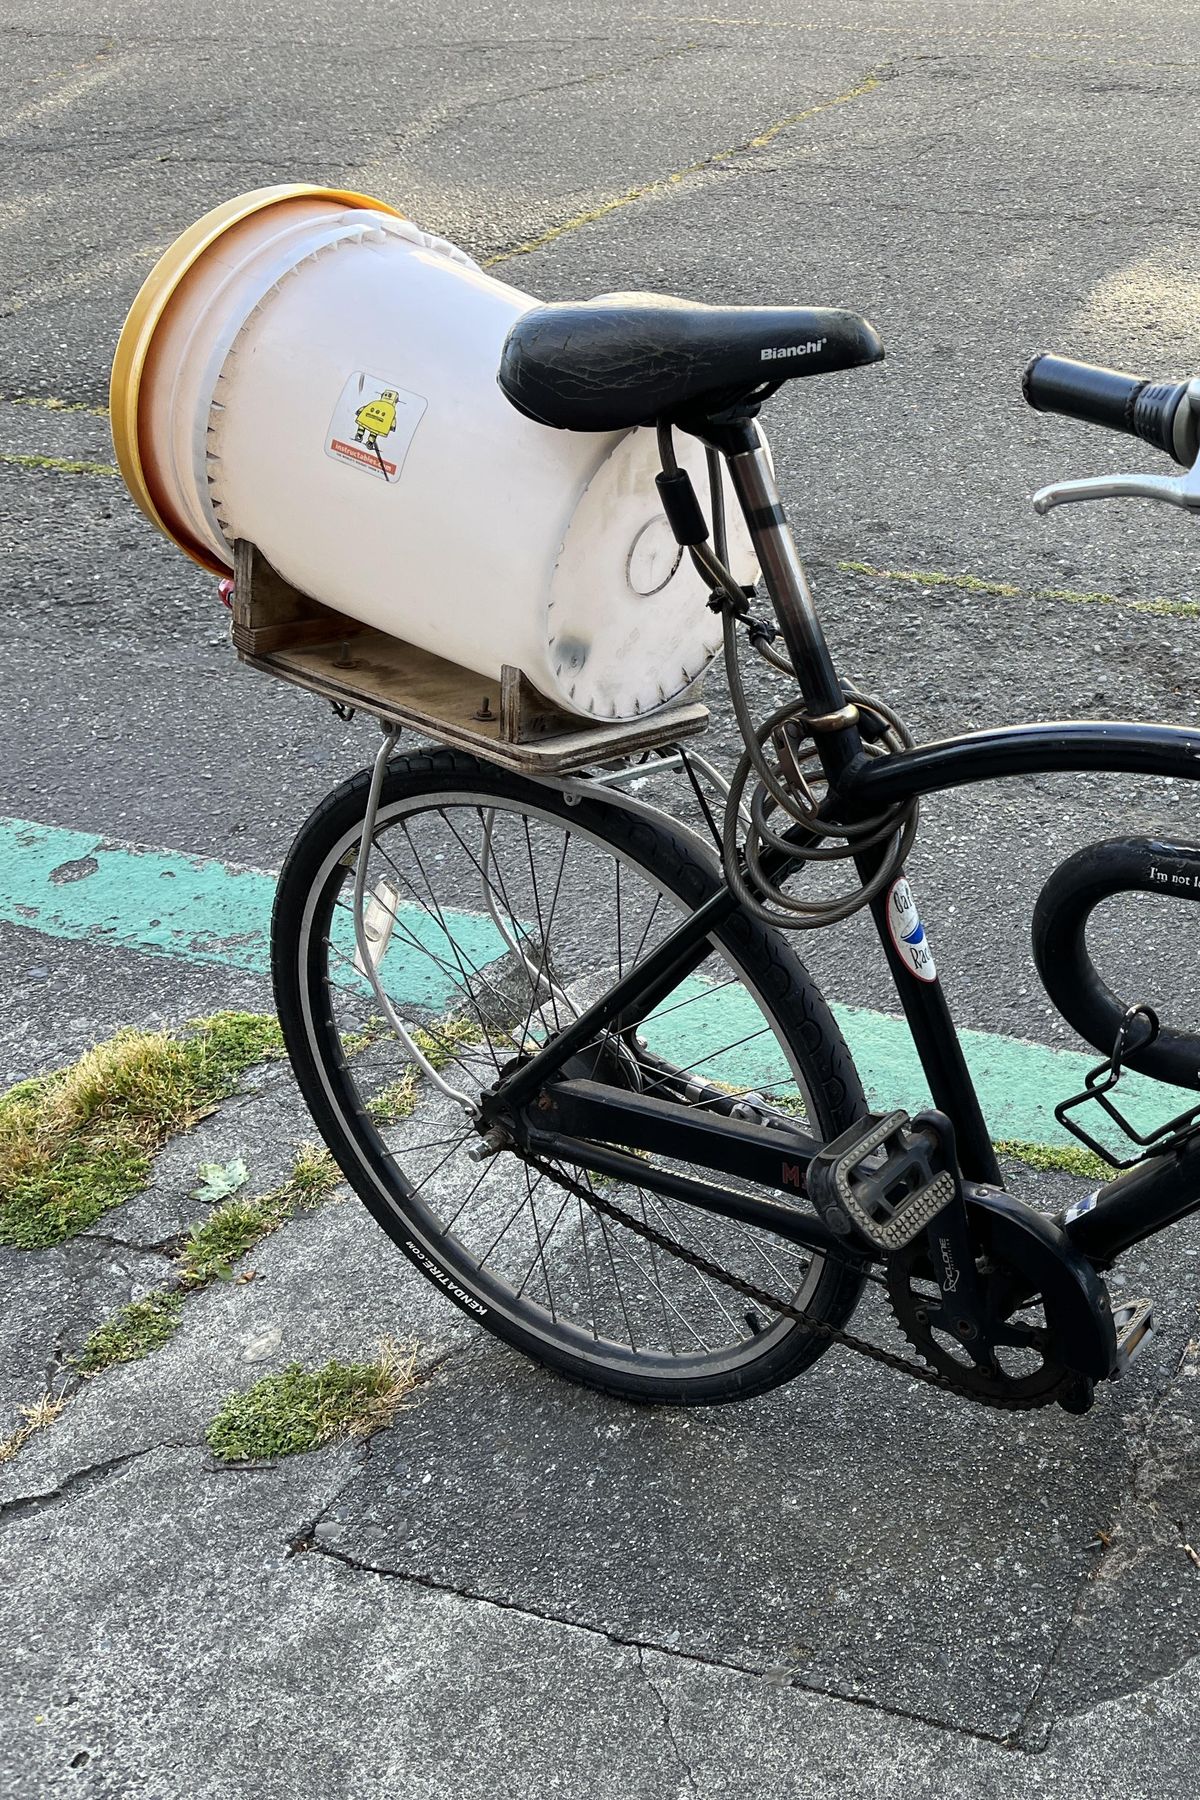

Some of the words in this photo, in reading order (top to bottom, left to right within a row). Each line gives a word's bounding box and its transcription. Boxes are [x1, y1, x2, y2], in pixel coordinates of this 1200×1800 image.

[1150, 867, 1168, 883] I'm
[1171, 873, 1191, 887] not
[405, 1241, 488, 1316] KENDATIRE.COM
